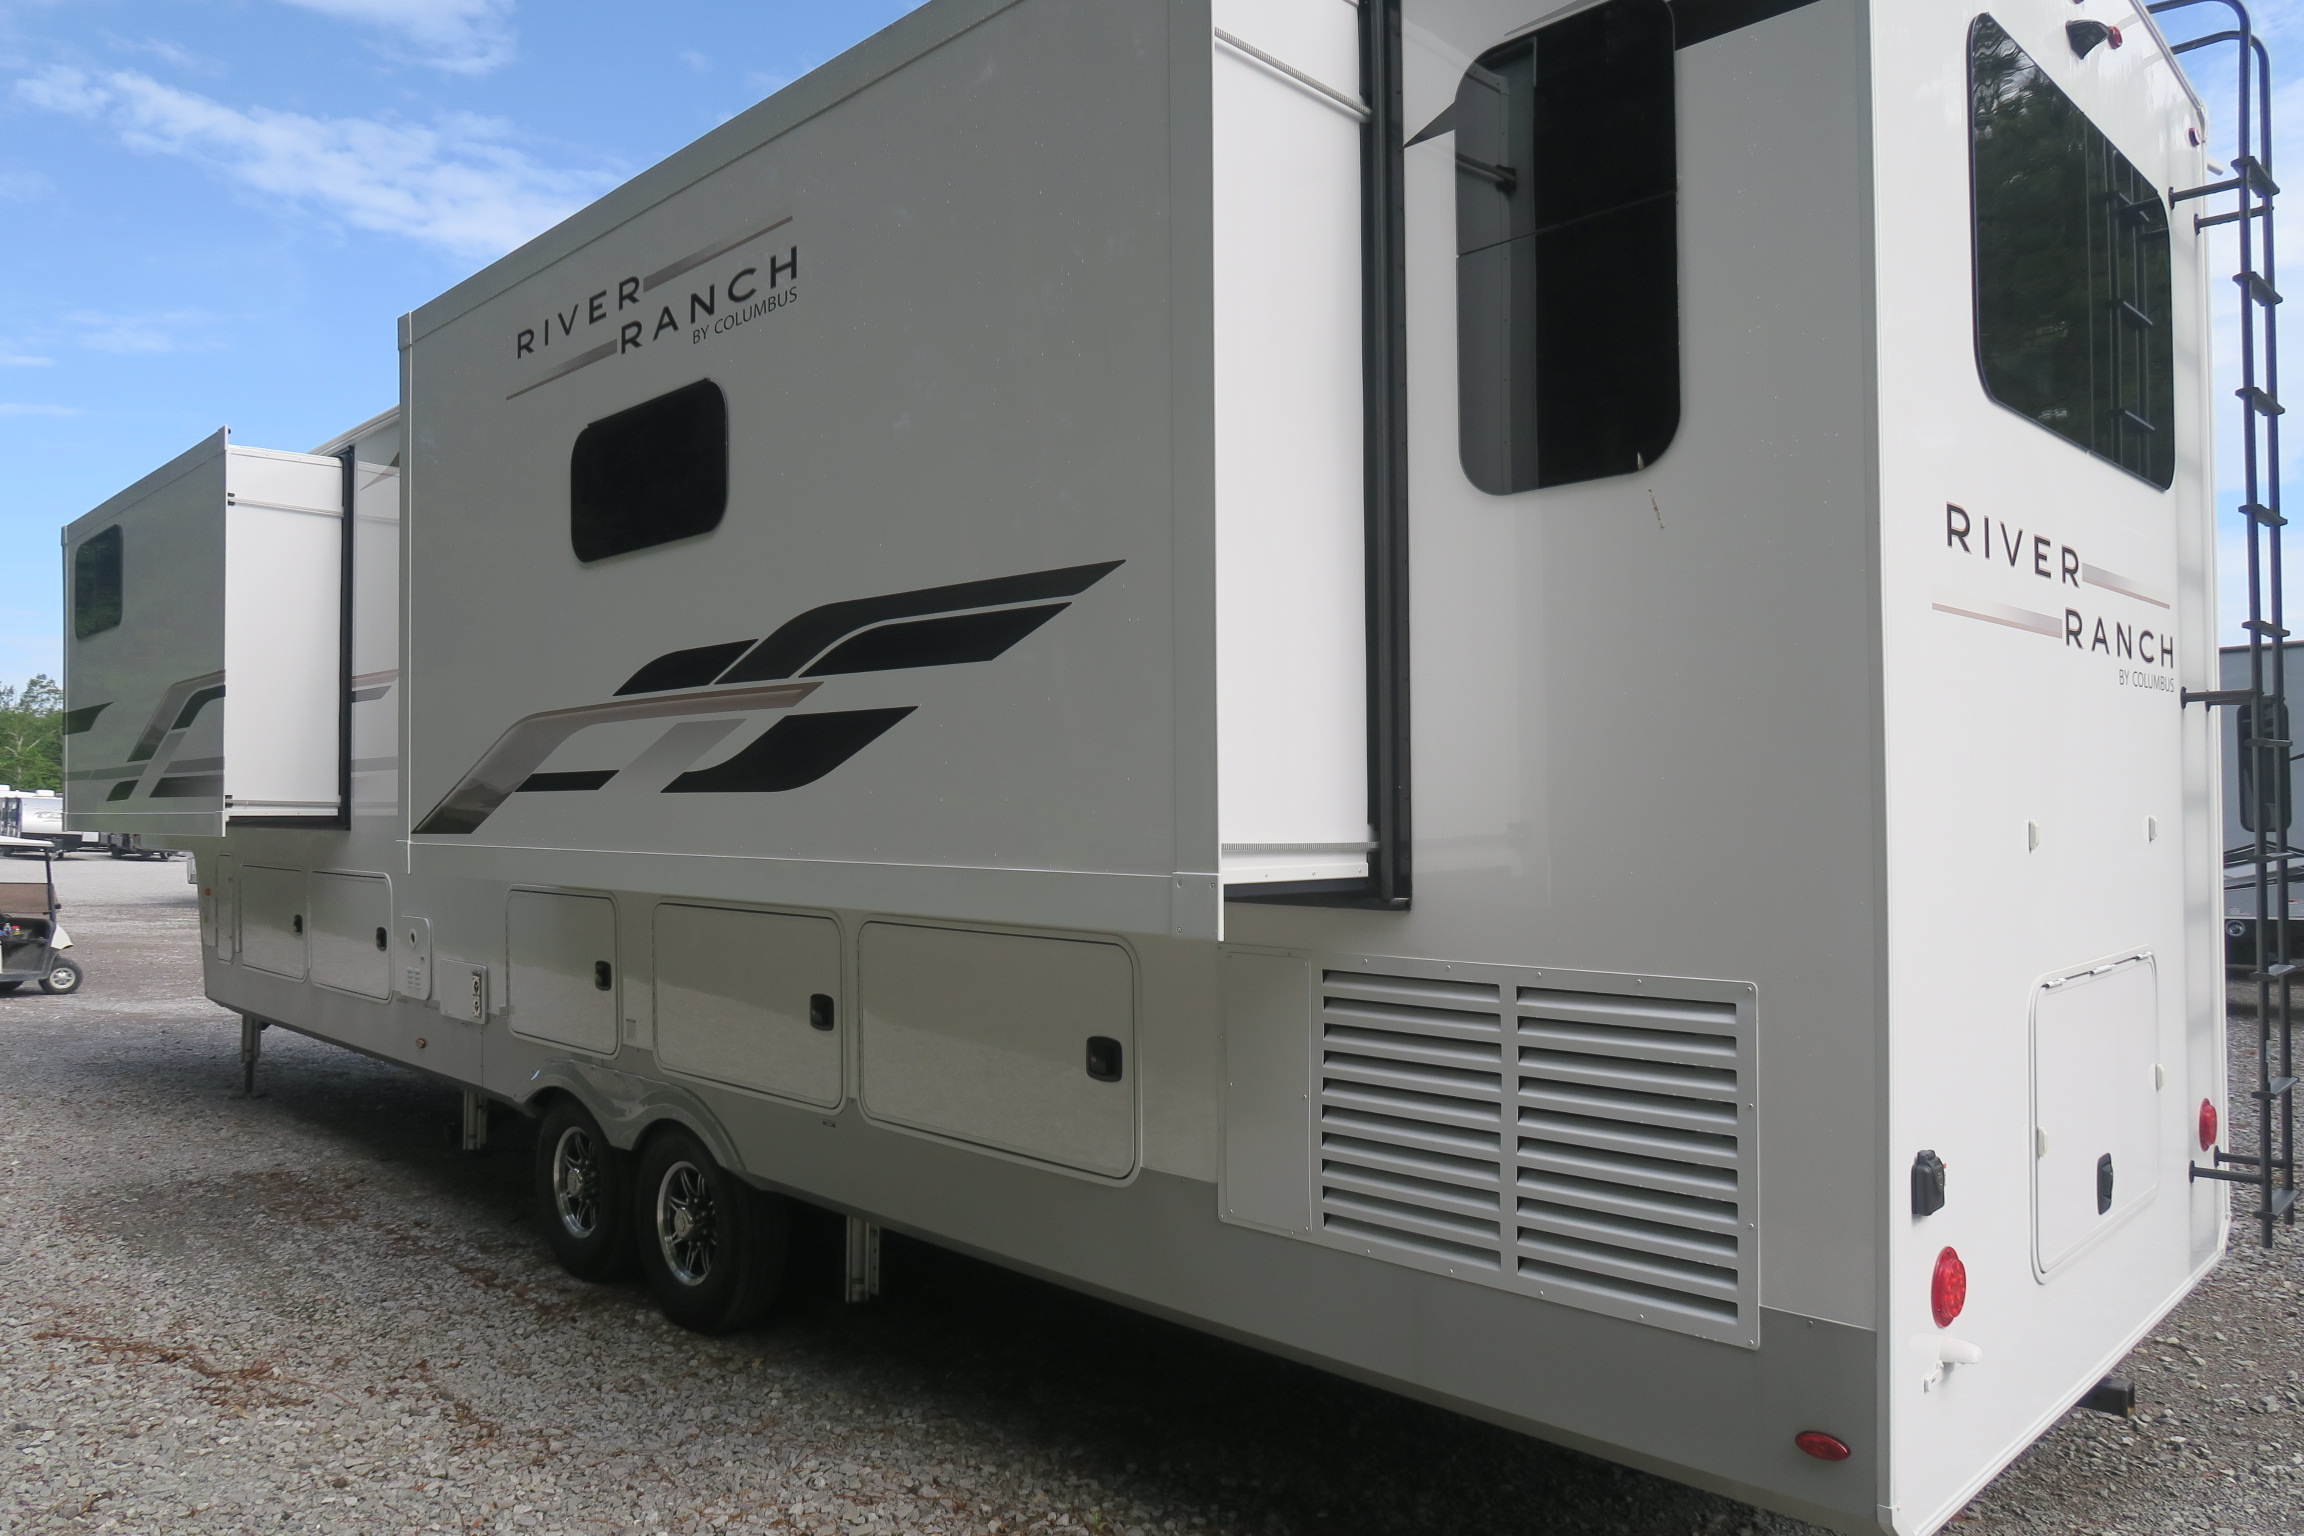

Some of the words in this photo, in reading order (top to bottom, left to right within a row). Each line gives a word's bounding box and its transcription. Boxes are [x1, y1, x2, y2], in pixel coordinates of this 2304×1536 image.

[517, 275, 641, 359] RIVER
[620, 245, 798, 355] RANCH
[692, 325, 709, 344] BY
[714, 286, 798, 334] COLUMBUS
[1946, 501, 2080, 588] RIVER
[2065, 607, 2174, 669] RANCH
[2118, 668, 2130, 686] BY
[2132, 670, 2175, 693] COLUMBUS
